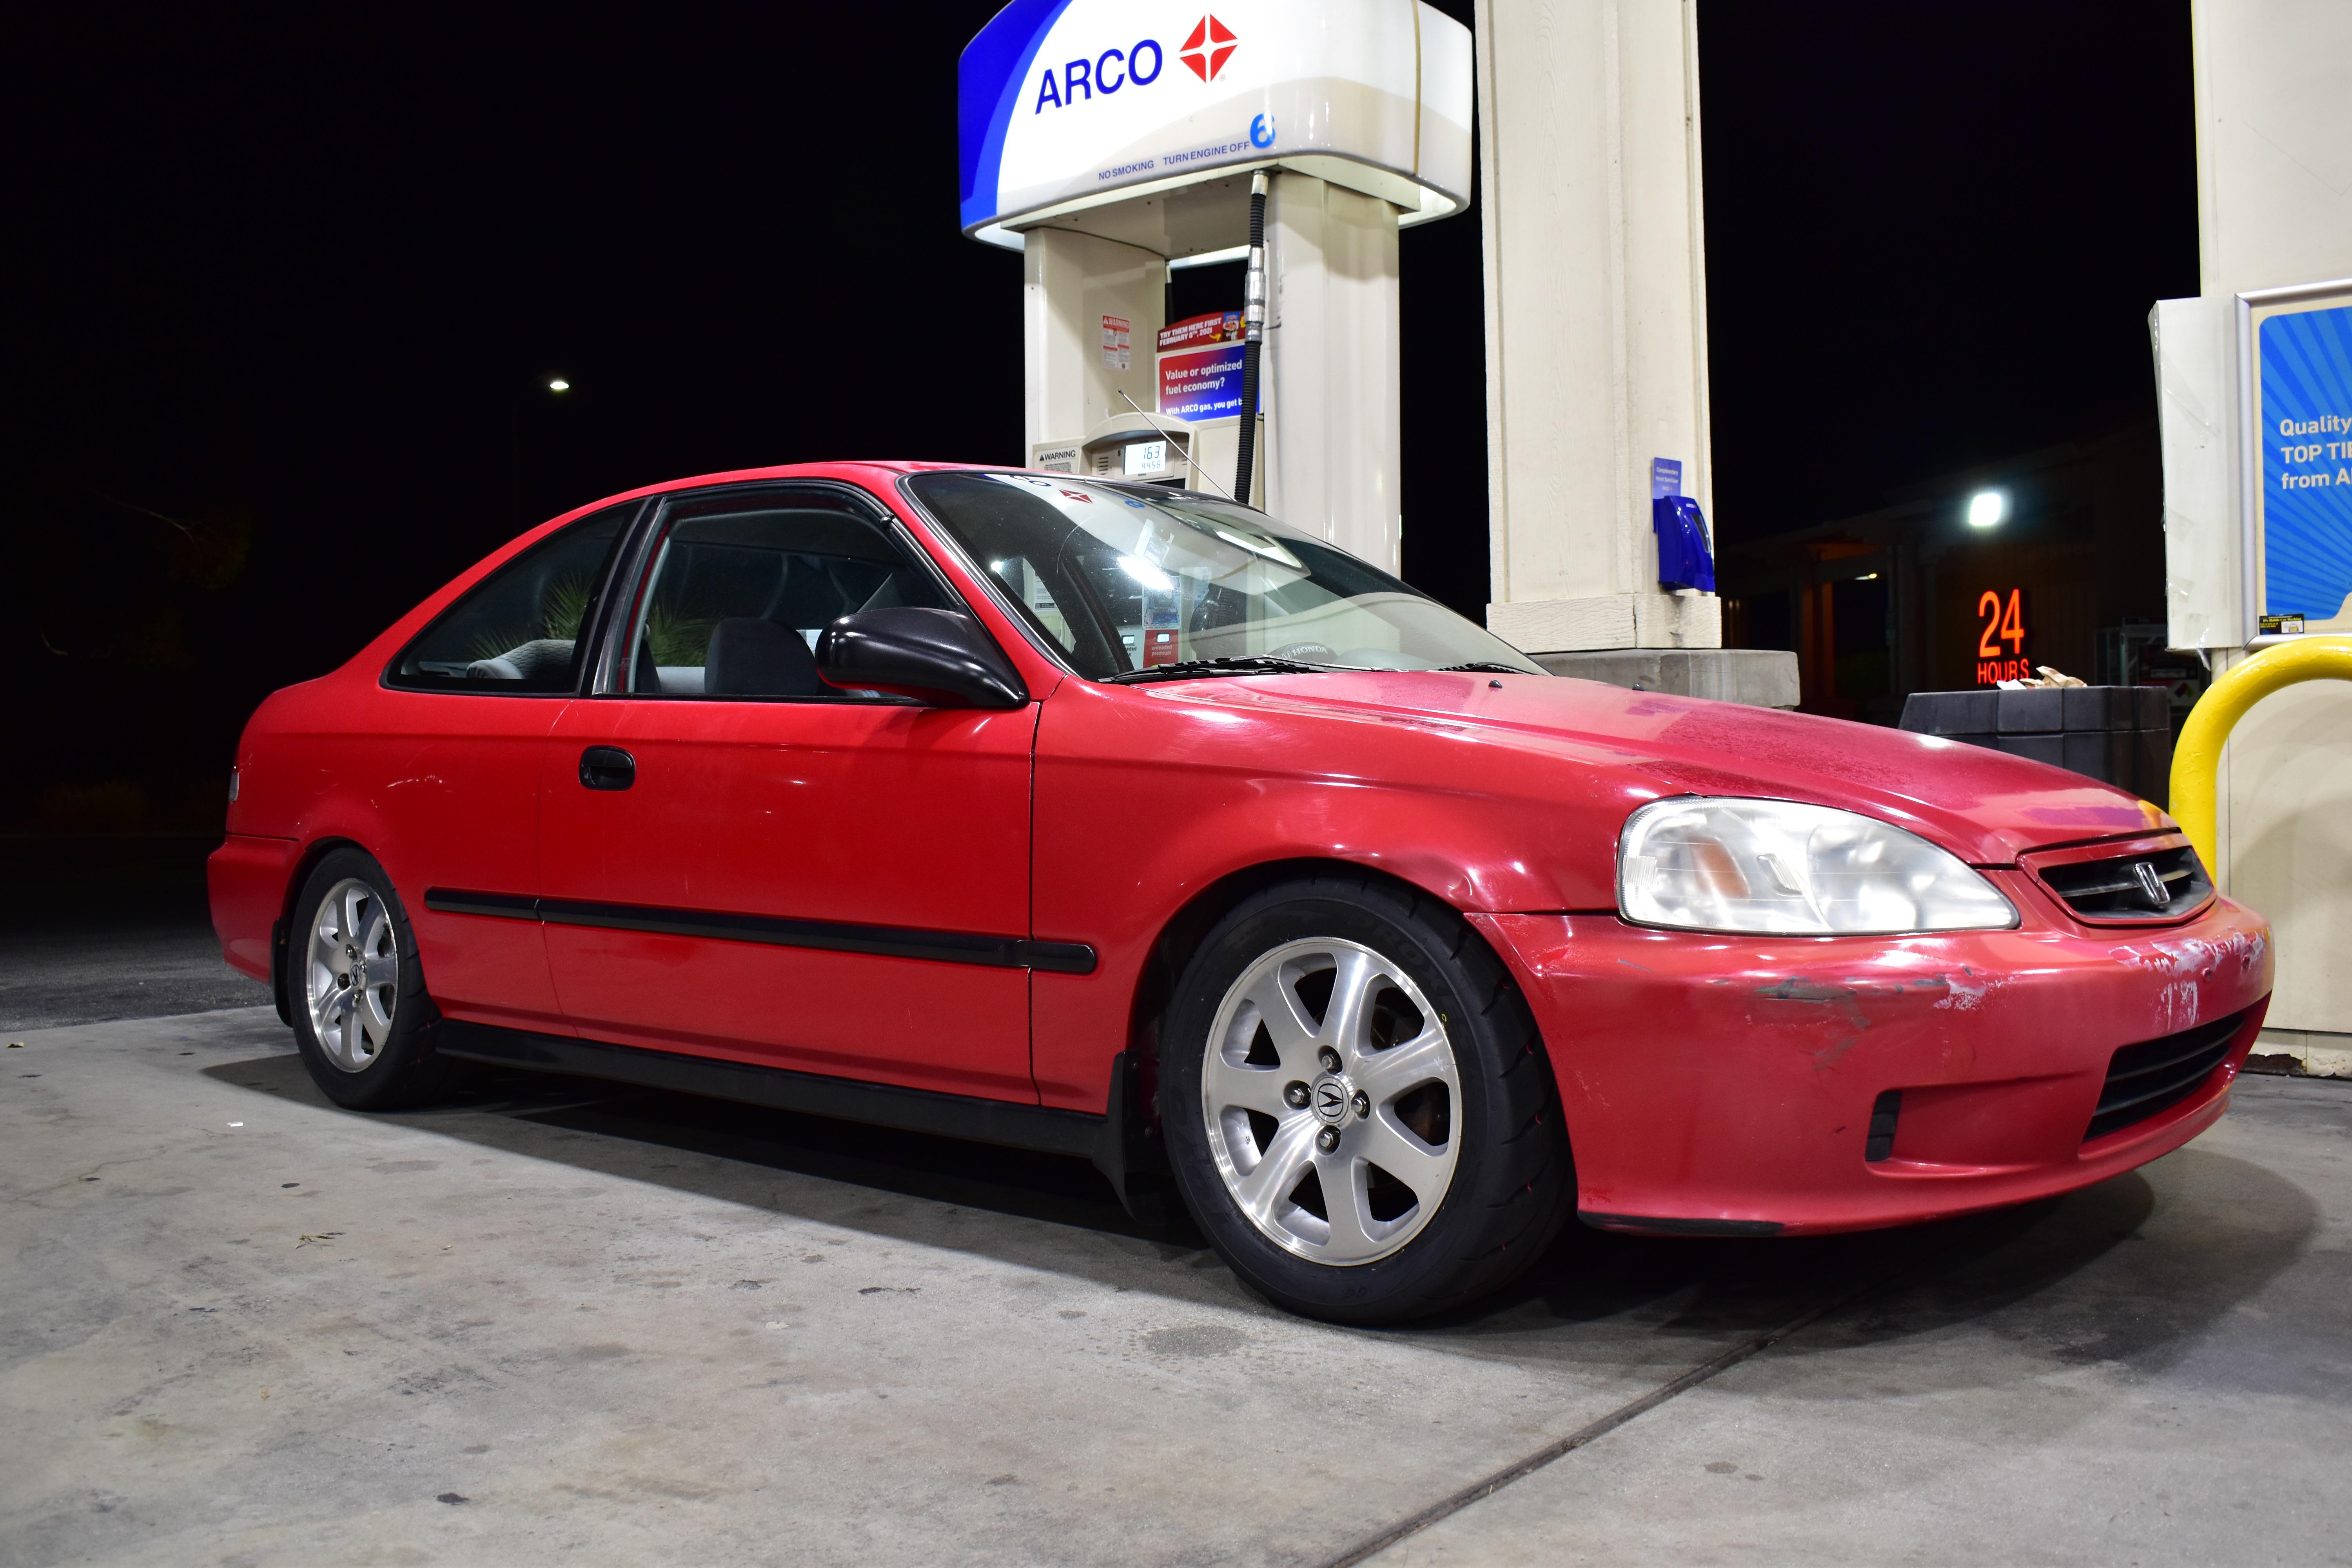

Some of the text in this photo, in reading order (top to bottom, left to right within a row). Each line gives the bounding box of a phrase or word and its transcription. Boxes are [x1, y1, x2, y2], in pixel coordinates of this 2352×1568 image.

[1035, 39, 1163, 115] ARCO
[1250, 113, 1276, 149] 6
[1099, 141, 1250, 180] NO SMOKING TURN ENGINE OFF
[1160, 318, 1222, 339] TRY THEM HERE FIRST
[1160, 334, 1188, 347] FEBRUARY
[1200, 327, 1212, 336] 2021
[1165, 359, 1242, 381] Value or optimized
[1166, 377, 1225, 395] fuel economy?
[1166, 407, 1180, 416] With
[1181, 404, 1198, 414] ARCO
[1214, 402, 1225, 410] you
[1227, 398, 1237, 409] get
[2280, 415, 2352, 436] Quality
[1045, 450, 1076, 460] WARNING
[1143, 445, 1160, 459] 163
[2281, 444, 2322, 464] TOP
[1142, 461, 1161, 470] 4458
[2281, 468, 2352, 490] from A
[1979, 589, 2024, 657] 24
[1292, 646, 1328, 657] HONDA
[1977, 658, 2029, 684] HOURS
